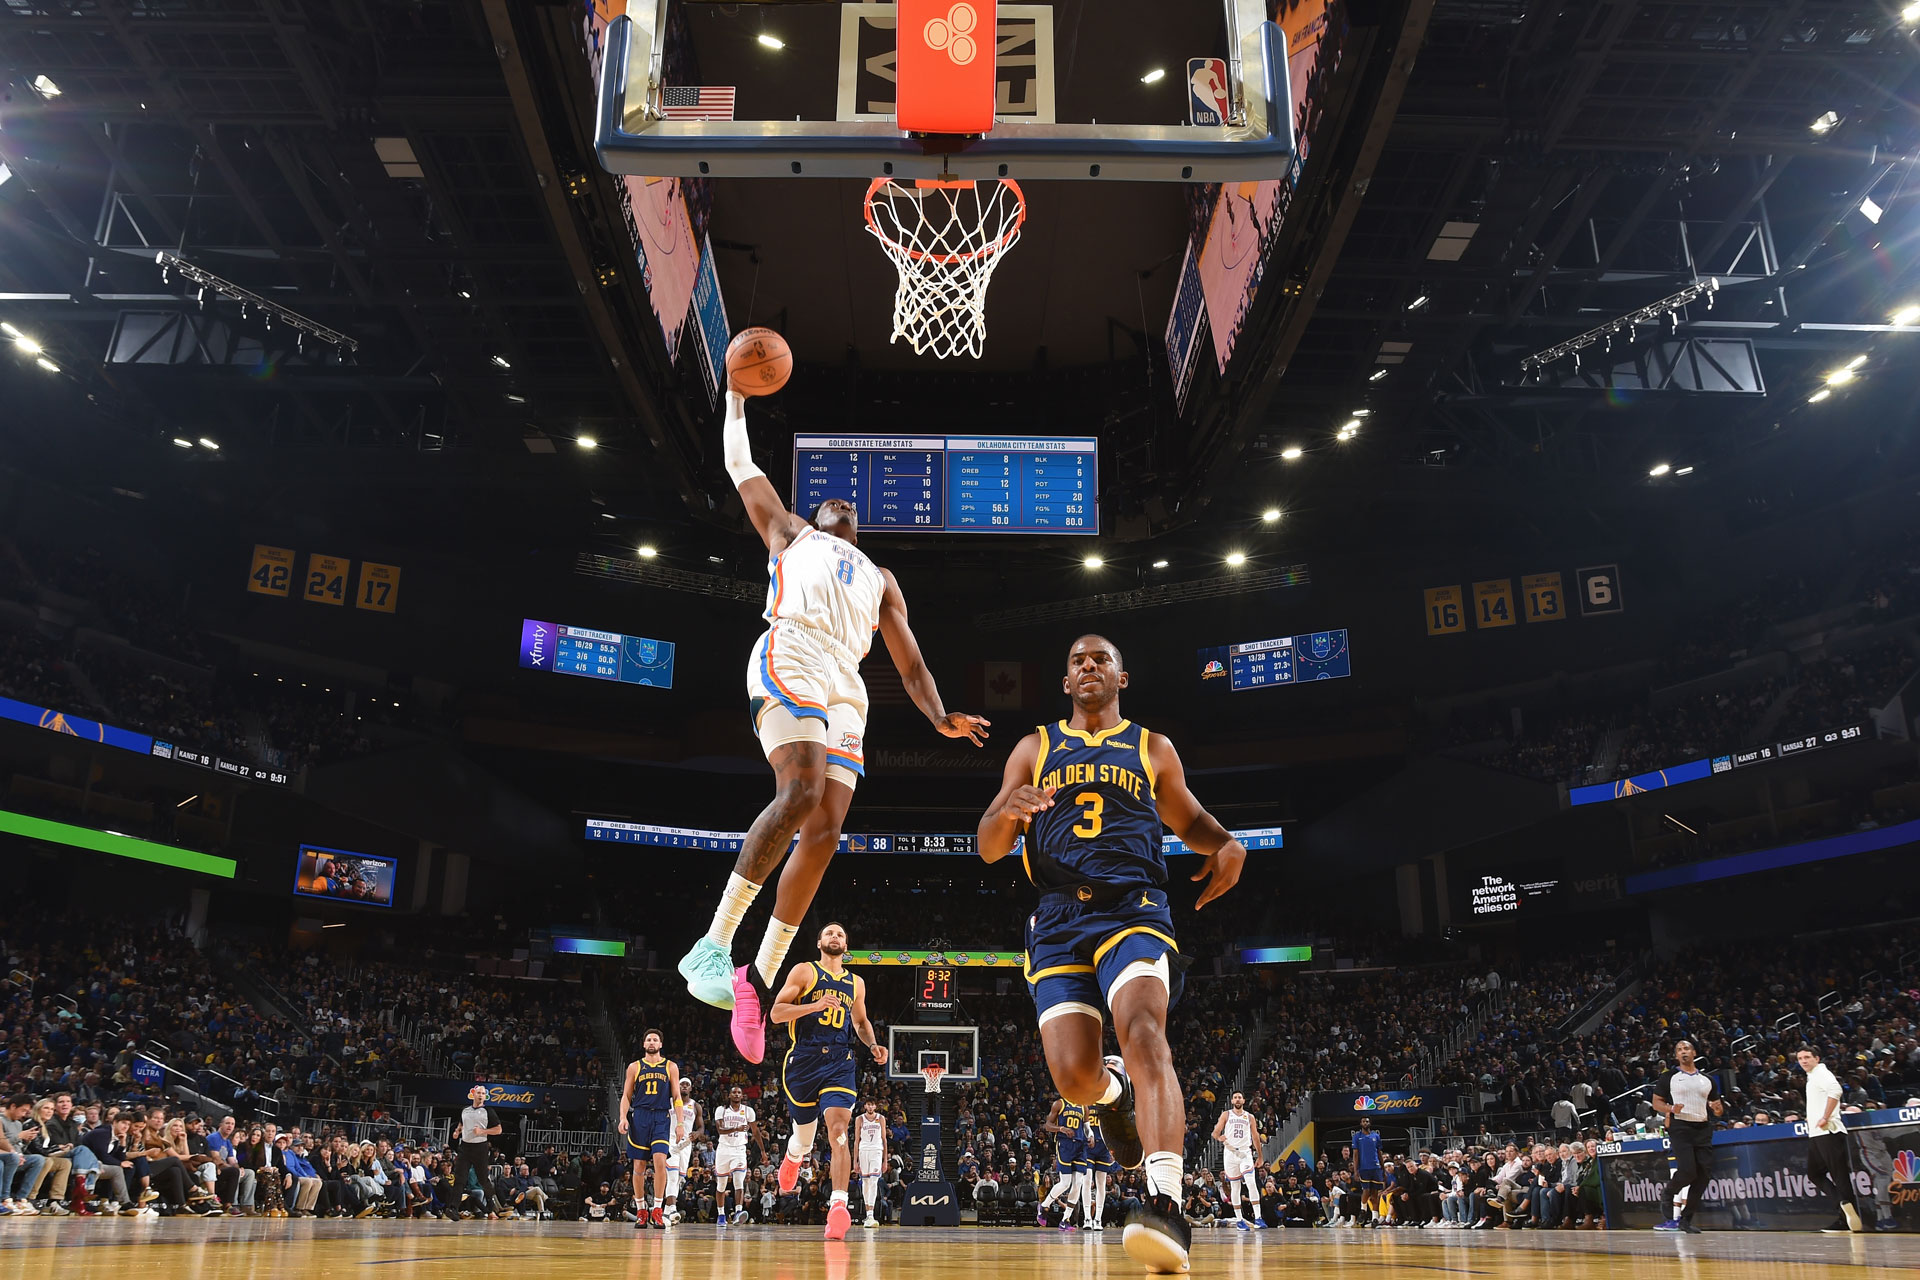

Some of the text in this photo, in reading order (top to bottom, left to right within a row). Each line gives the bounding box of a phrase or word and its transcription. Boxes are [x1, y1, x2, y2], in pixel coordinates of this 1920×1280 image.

[1196, 112, 1215, 123] NBA
[850, 453, 858, 461] 12
[926, 454, 932, 462] 2
[1004, 455, 1009, 463] 8
[1077, 456, 1082, 464] 2
[852, 465, 857, 474] 3
[926, 466, 931, 474] 5
[1004, 467, 1009, 475] 2
[1077, 468, 1082, 476] 6
[850, 478, 857, 486] 11
[923, 479, 931, 487] 10
[1000, 479, 1009, 488] 12
[1077, 481, 1082, 489] 9
[852, 490, 857, 498] 4
[923, 491, 931, 499] 16
[1005, 492, 1009, 500] 1
[1073, 493, 1082, 501] 20
[914, 503, 931, 511] 46.4
[992, 504, 1009, 512] 56.5
[1066, 505, 1083, 513] 55.2
[915, 516, 930, 524] 81.8
[992, 516, 1009, 524] 50.0
[1065, 518, 1083, 526] 80.0
[253, 564, 288, 590] 42
[836, 558, 855, 586] 8
[309, 572, 343, 599] 24
[1587, 575, 1612, 605] 6
[364, 580, 391, 606] 17
[1530, 590, 1558, 617] 13
[1481, 597, 1508, 622] 14
[1432, 603, 1458, 629] 16
[574, 629, 612, 641] SHOT TRACKER
[530, 624, 548, 666] xfinity
[575, 640, 593, 650] 16/29
[1259, 640, 1284, 649] TRACKER
[576, 652, 588, 660] 3/6
[1248, 653, 1266, 662] 13/28
[576, 663, 587, 671] 4/5
[1251, 664, 1264, 673] 3/11
[1201, 669, 1228, 680] Sports
[1252, 676, 1265, 684] 9/11
[1783, 726, 1861, 752] KANSAS 27 Q3 9:51
[1106, 740, 1135, 749] Rakuten
[179, 750, 209, 765] KANST 16
[875, 750, 926, 768] Modelo
[1738, 748, 1770, 763] KANST 16
[220, 761, 286, 783] KANSAS 27 Q3 9:51
[1042, 764, 1143, 800] GOLDEN STATE
[1072, 792, 1104, 838] 3
[654, 835, 659, 843] 4
[673, 837, 678, 845] 2
[710, 840, 718, 848] 10
[873, 838, 886, 850] 38
[924, 837, 945, 847] 8:33
[1260, 838, 1275, 846] 80.0
[362, 859, 387, 868] verizon
[1482, 876, 1502, 886] The
[1472, 883, 1515, 896] network
[1472, 893, 1516, 905] America
[1474, 902, 1517, 914] relies on
[928, 970, 950, 981] 8:32
[923, 981, 947, 999] 21
[818, 1006, 845, 1028] 30
[136, 1068, 160, 1077] ULTRA
[645, 1081, 658, 1094] 11
[490, 1087, 535, 1104] Sports
[1375, 1095, 1422, 1112] Sports
[1066, 1117, 1079, 1129] 00
[1234, 1129, 1243, 1138] 29
[1596, 1144, 1615, 1154] CHASE
[1624, 1178, 1668, 1202] Authe
[1774, 1167, 1817, 1198] Live
